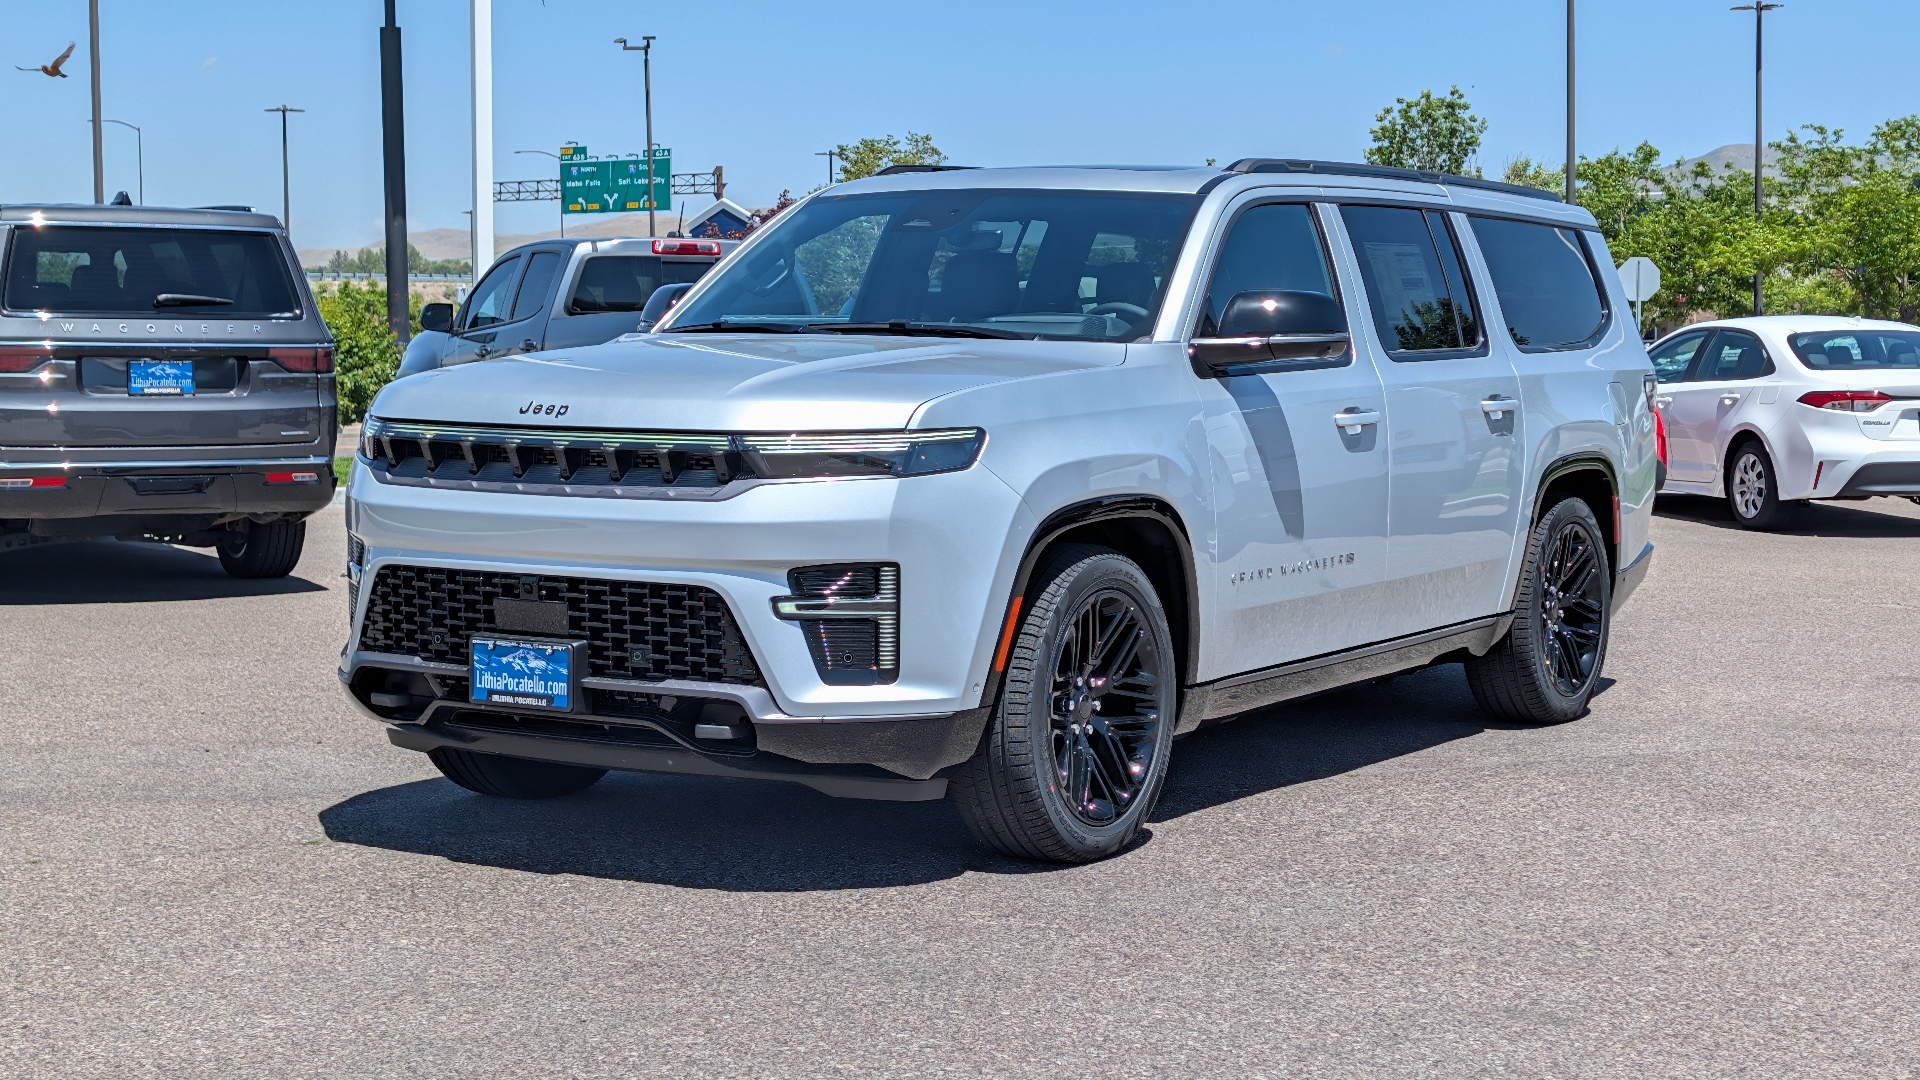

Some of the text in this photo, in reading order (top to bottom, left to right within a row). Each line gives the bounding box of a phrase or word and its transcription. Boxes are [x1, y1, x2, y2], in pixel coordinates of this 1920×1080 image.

[60, 322, 261, 334] WAGONEER
[131, 376, 192, 388] LithiaPocatello.com
[519, 400, 569, 419] Jeep
[1231, 567, 1273, 586] GRAND
[1280, 554, 1344, 577] WAGONEER
[476, 670, 567, 695] LithiaPocatello.com
